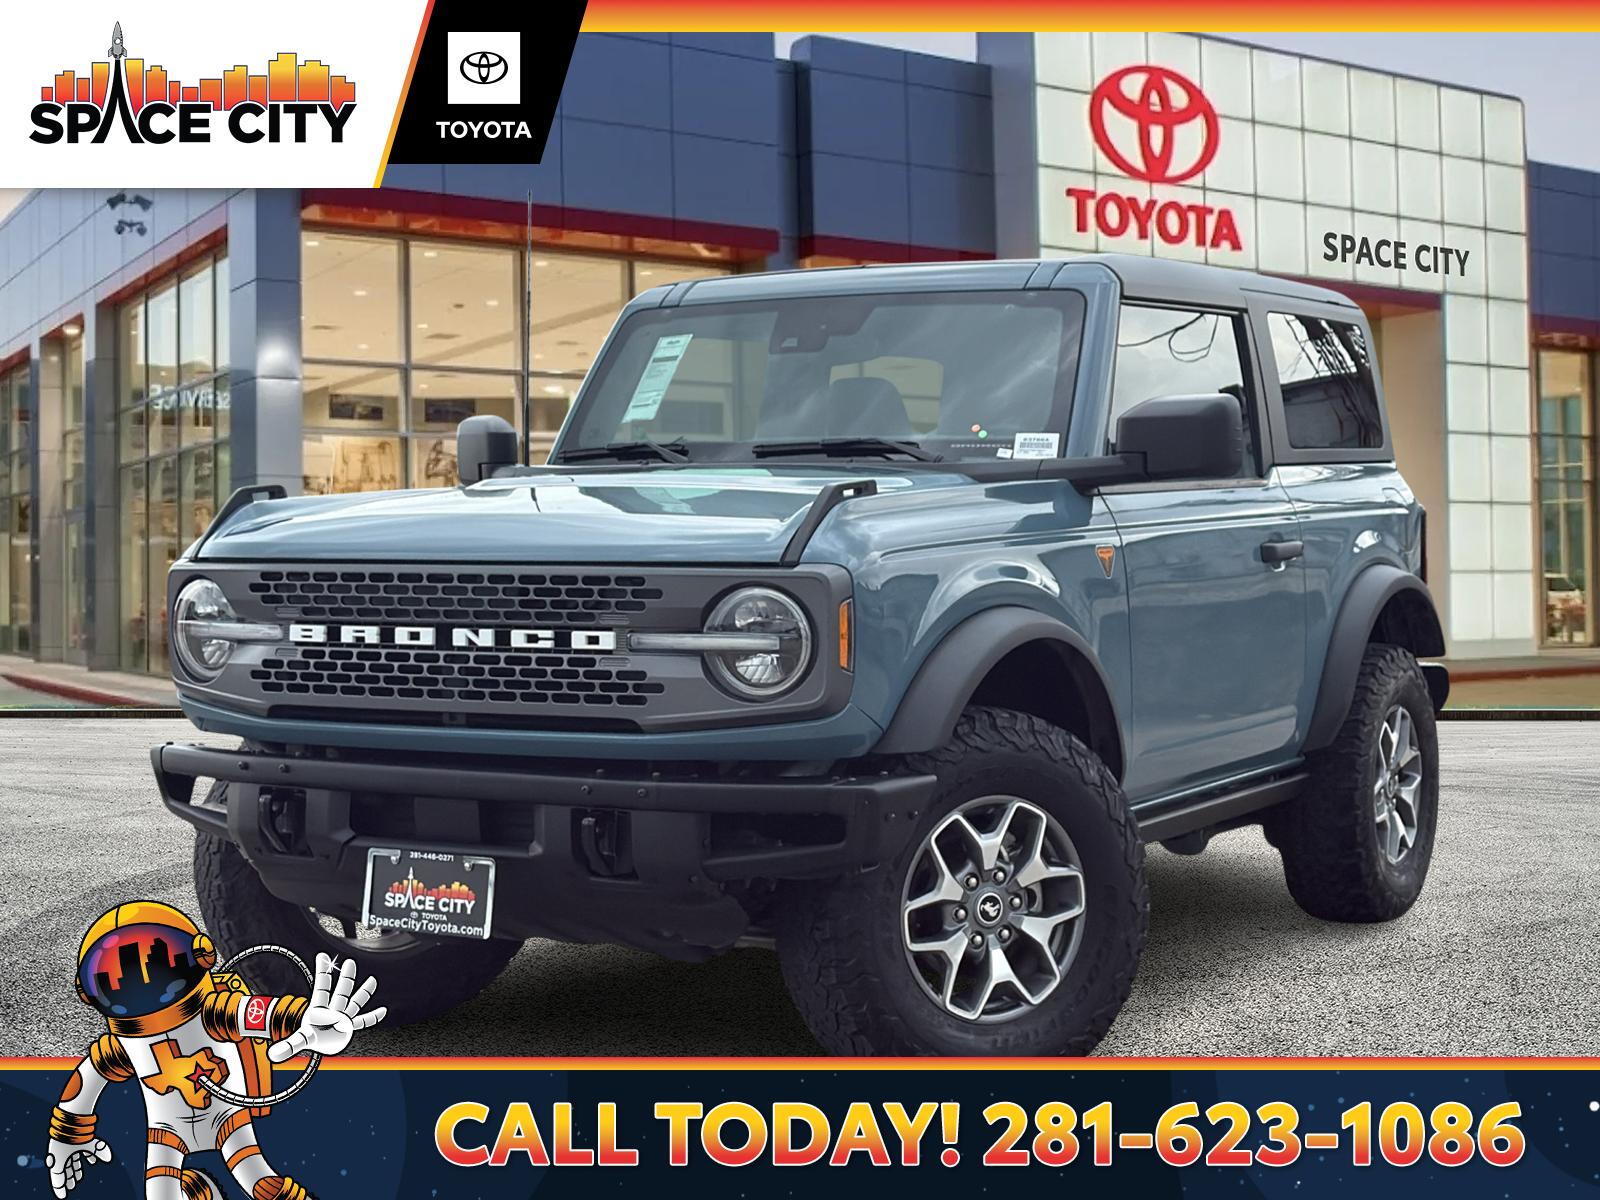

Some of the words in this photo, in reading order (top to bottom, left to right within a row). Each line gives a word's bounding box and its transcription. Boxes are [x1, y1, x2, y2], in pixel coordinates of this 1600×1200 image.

[1066, 187, 1242, 251] TOYOTA
[1323, 232, 1407, 270] SPACE
[1415, 244, 1470, 277] CITY
[289, 624, 616, 650] BRONCO
[421, 912, 448, 921] TOYOTA
[438, 897, 476, 915] CITY
[369, 914, 484, 936] SpaceCityToyota.com
